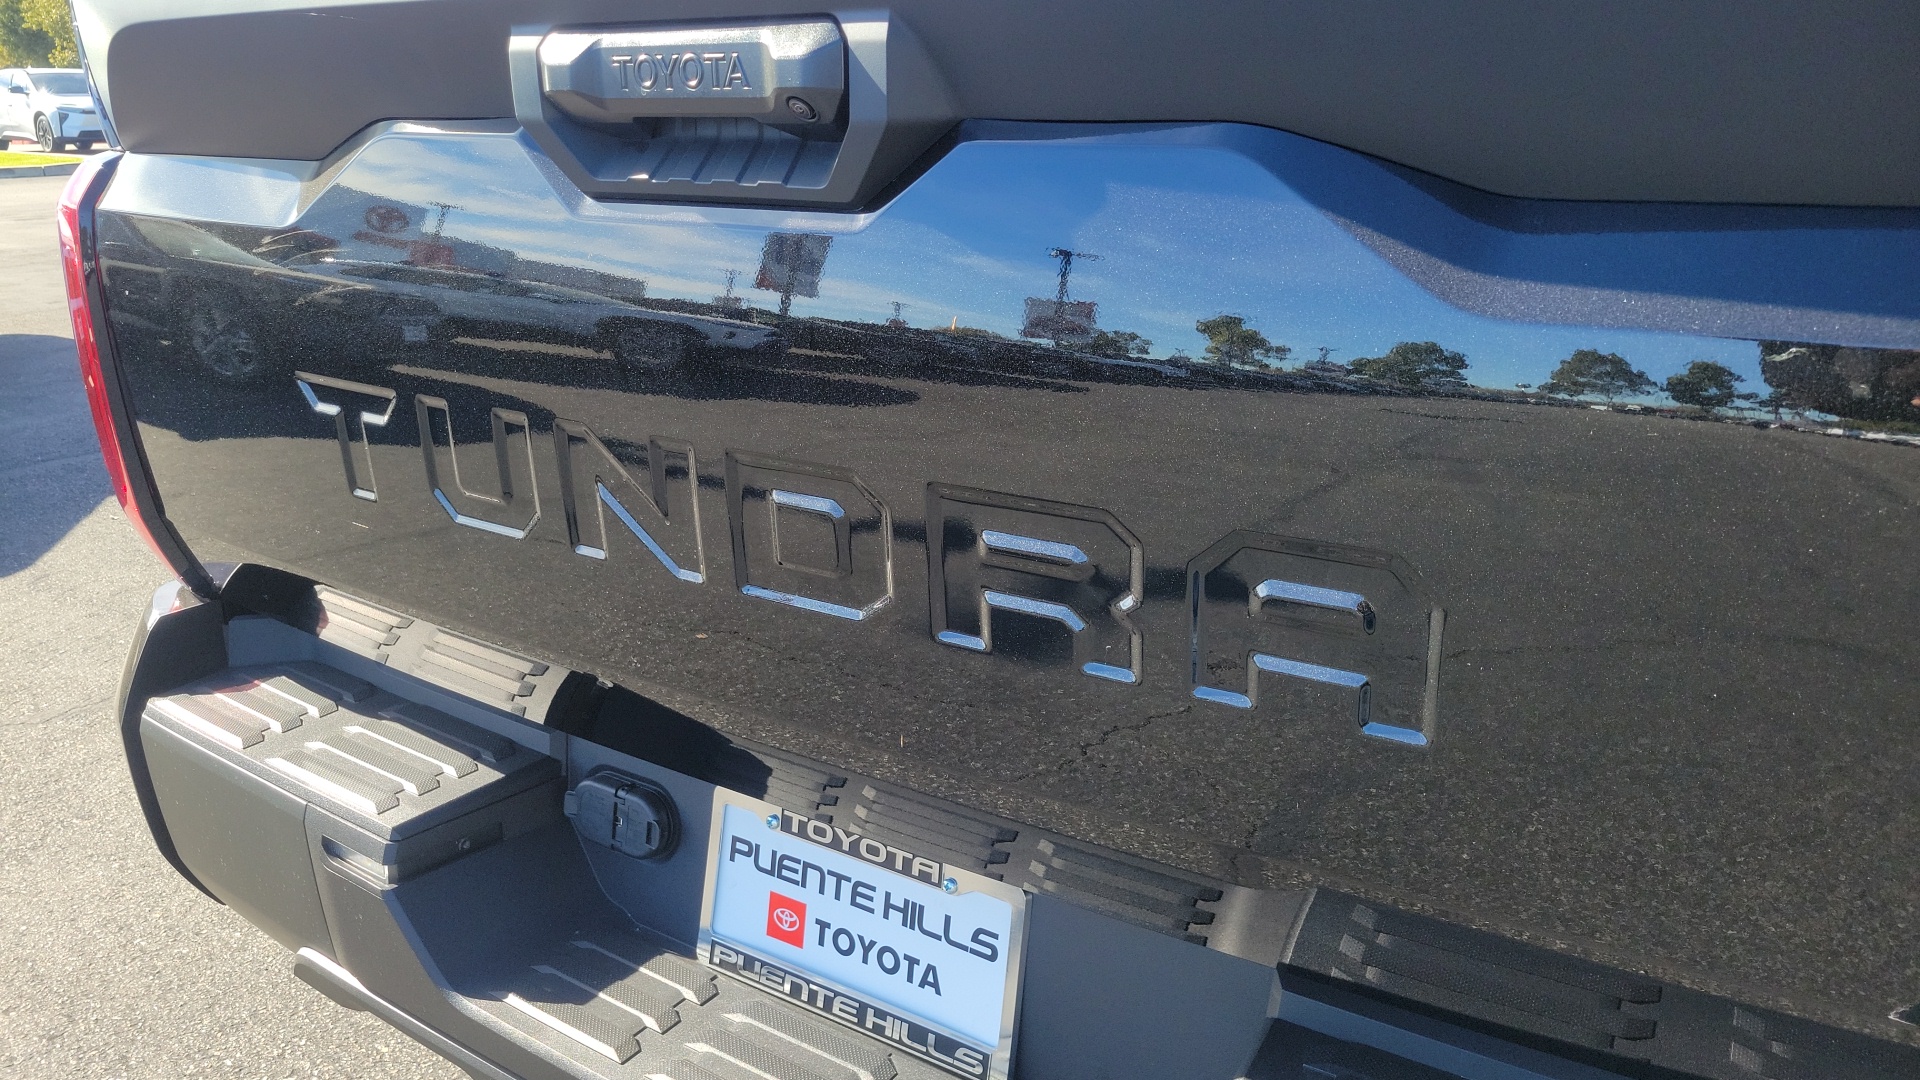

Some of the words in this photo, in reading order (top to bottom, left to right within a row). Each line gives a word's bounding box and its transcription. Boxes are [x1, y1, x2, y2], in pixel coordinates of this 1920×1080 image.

[612, 52, 752, 91] TOYOTA
[295, 370, 1447, 746] TUNDRA
[783, 810, 941, 884] TOYOTA
[729, 835, 877, 915] PUENTE
[883, 890, 999, 963] HILLS
[814, 918, 942, 996] TOYOTA
[713, 948, 860, 1023] PUENTE
[865, 1008, 985, 1076] HILLS
